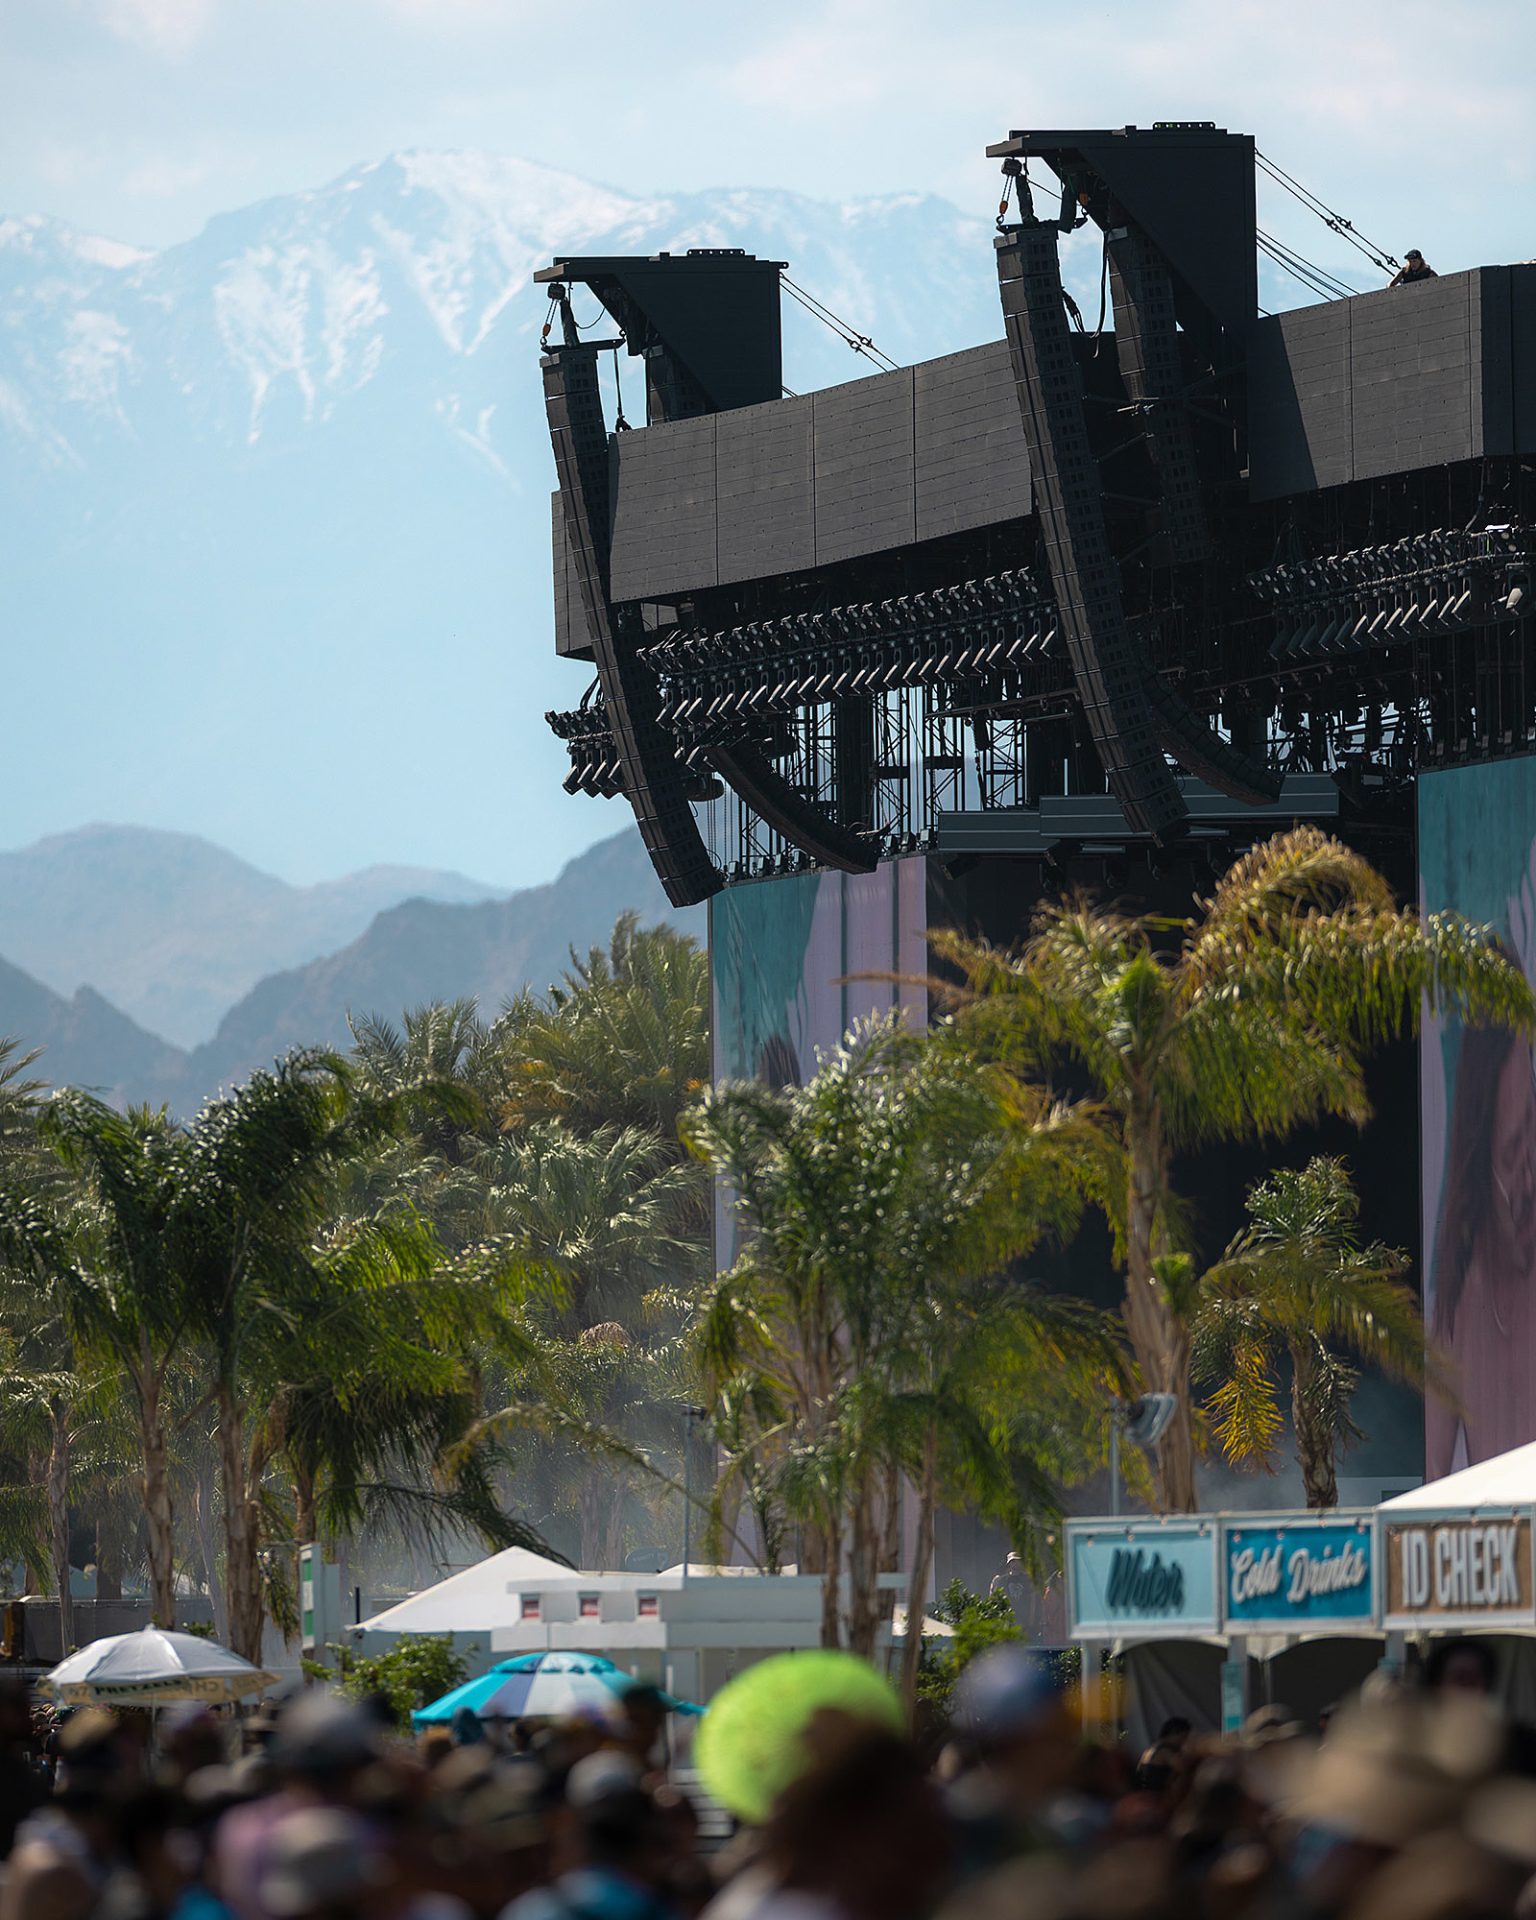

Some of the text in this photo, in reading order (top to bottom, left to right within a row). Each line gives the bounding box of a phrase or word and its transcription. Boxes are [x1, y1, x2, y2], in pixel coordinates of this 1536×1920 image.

[1231, 1539, 1367, 1604] Cold Drinks
[1401, 1525, 1519, 1606] ID CHECK
